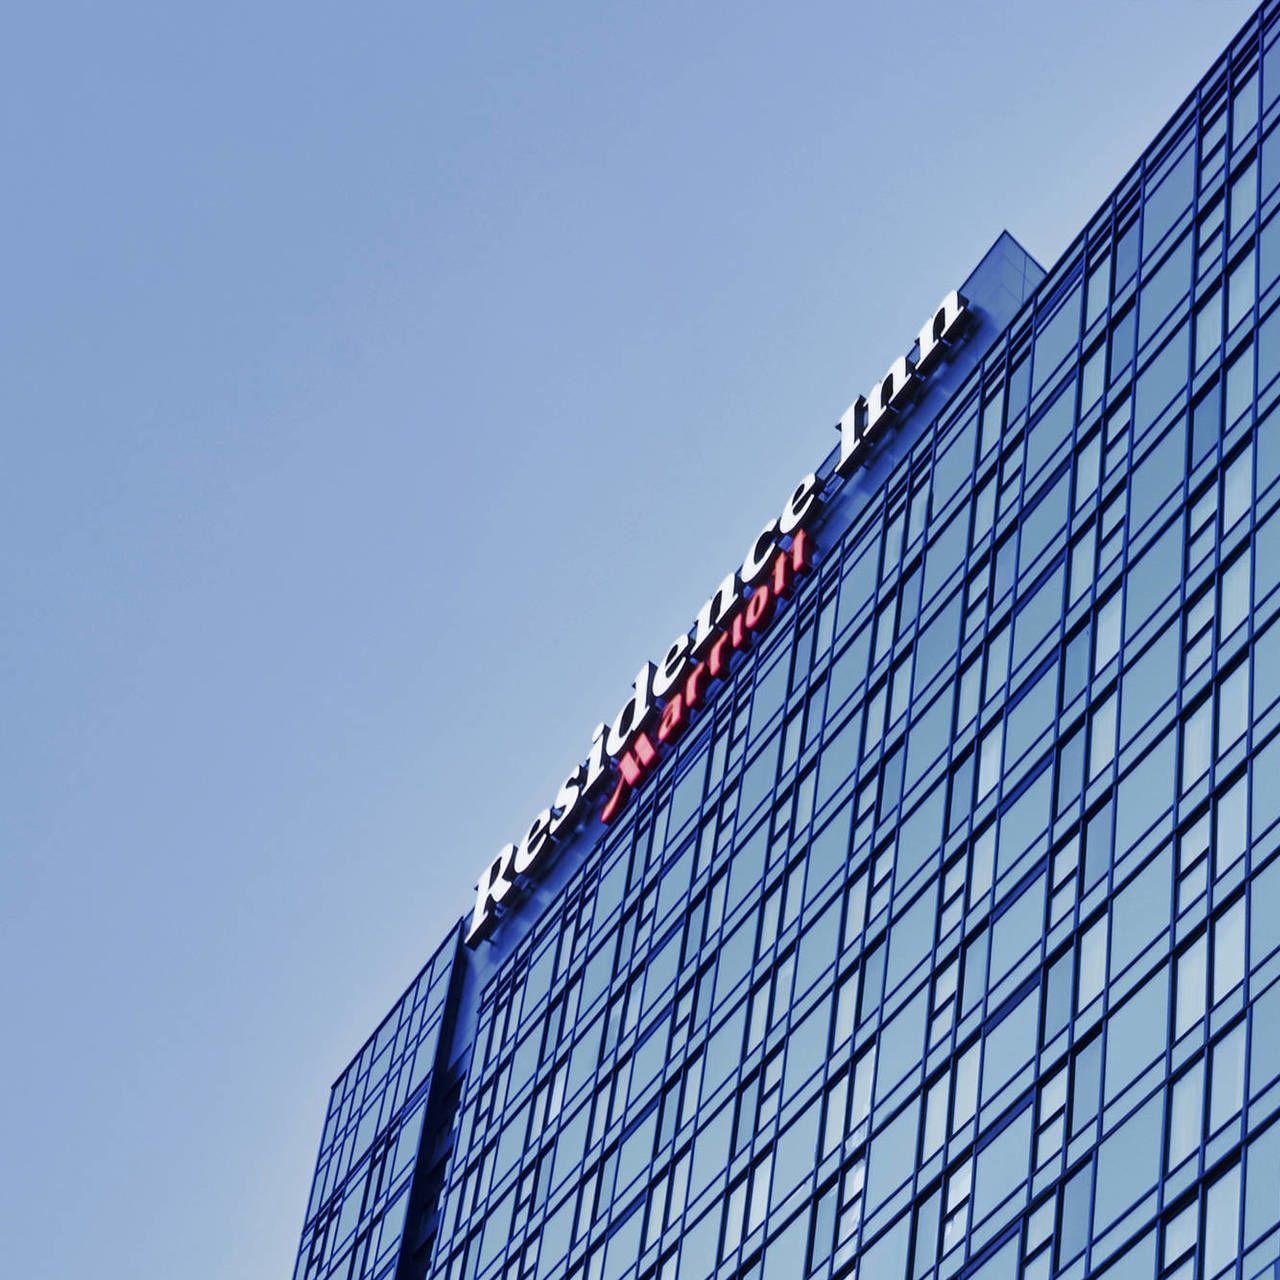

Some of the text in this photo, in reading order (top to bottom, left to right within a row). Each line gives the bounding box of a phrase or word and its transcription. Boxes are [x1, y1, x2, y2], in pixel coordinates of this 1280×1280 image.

[463, 289, 968, 945] Residence Inn
[601, 528, 808, 823] Marriott
